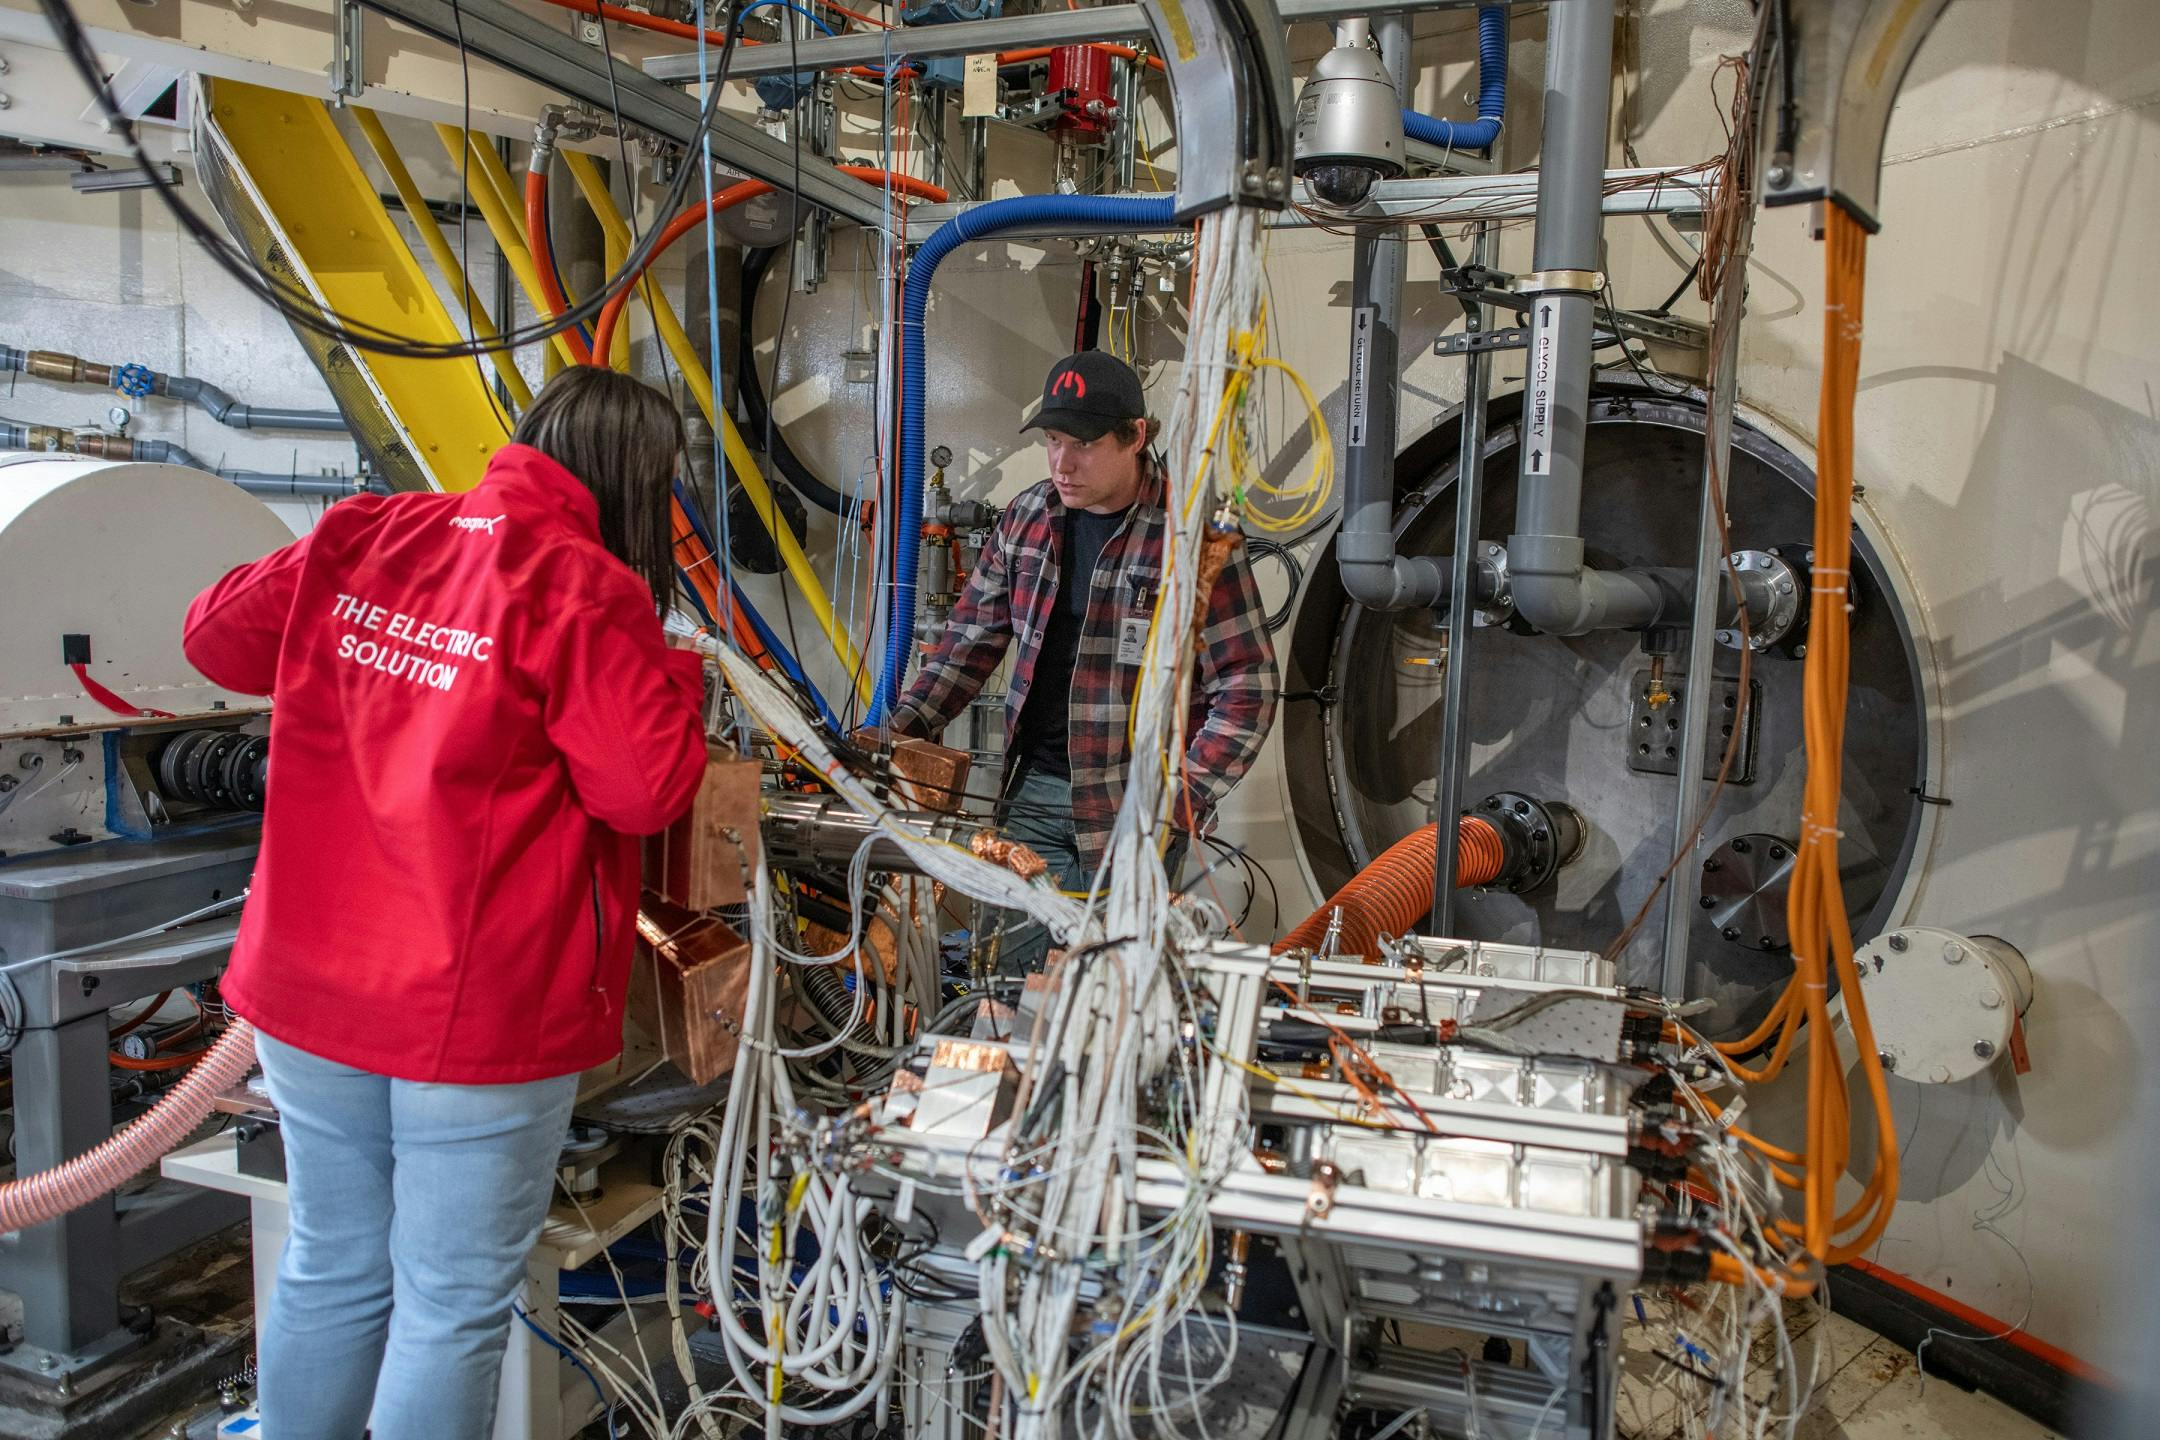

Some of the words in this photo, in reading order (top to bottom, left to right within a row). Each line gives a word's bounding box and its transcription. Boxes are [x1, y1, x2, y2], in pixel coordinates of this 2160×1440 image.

[1355, 337, 1366, 377] GLYCOL
[1536, 337, 1549, 387] GLYCOL
[1353, 379, 1362, 418] RETURN
[1533, 390, 1546, 437] SUPPLY
[331, 593, 388, 631] THE
[385, 613, 494, 662] ELECTRIC
[337, 634, 459, 691] SOLUTION
